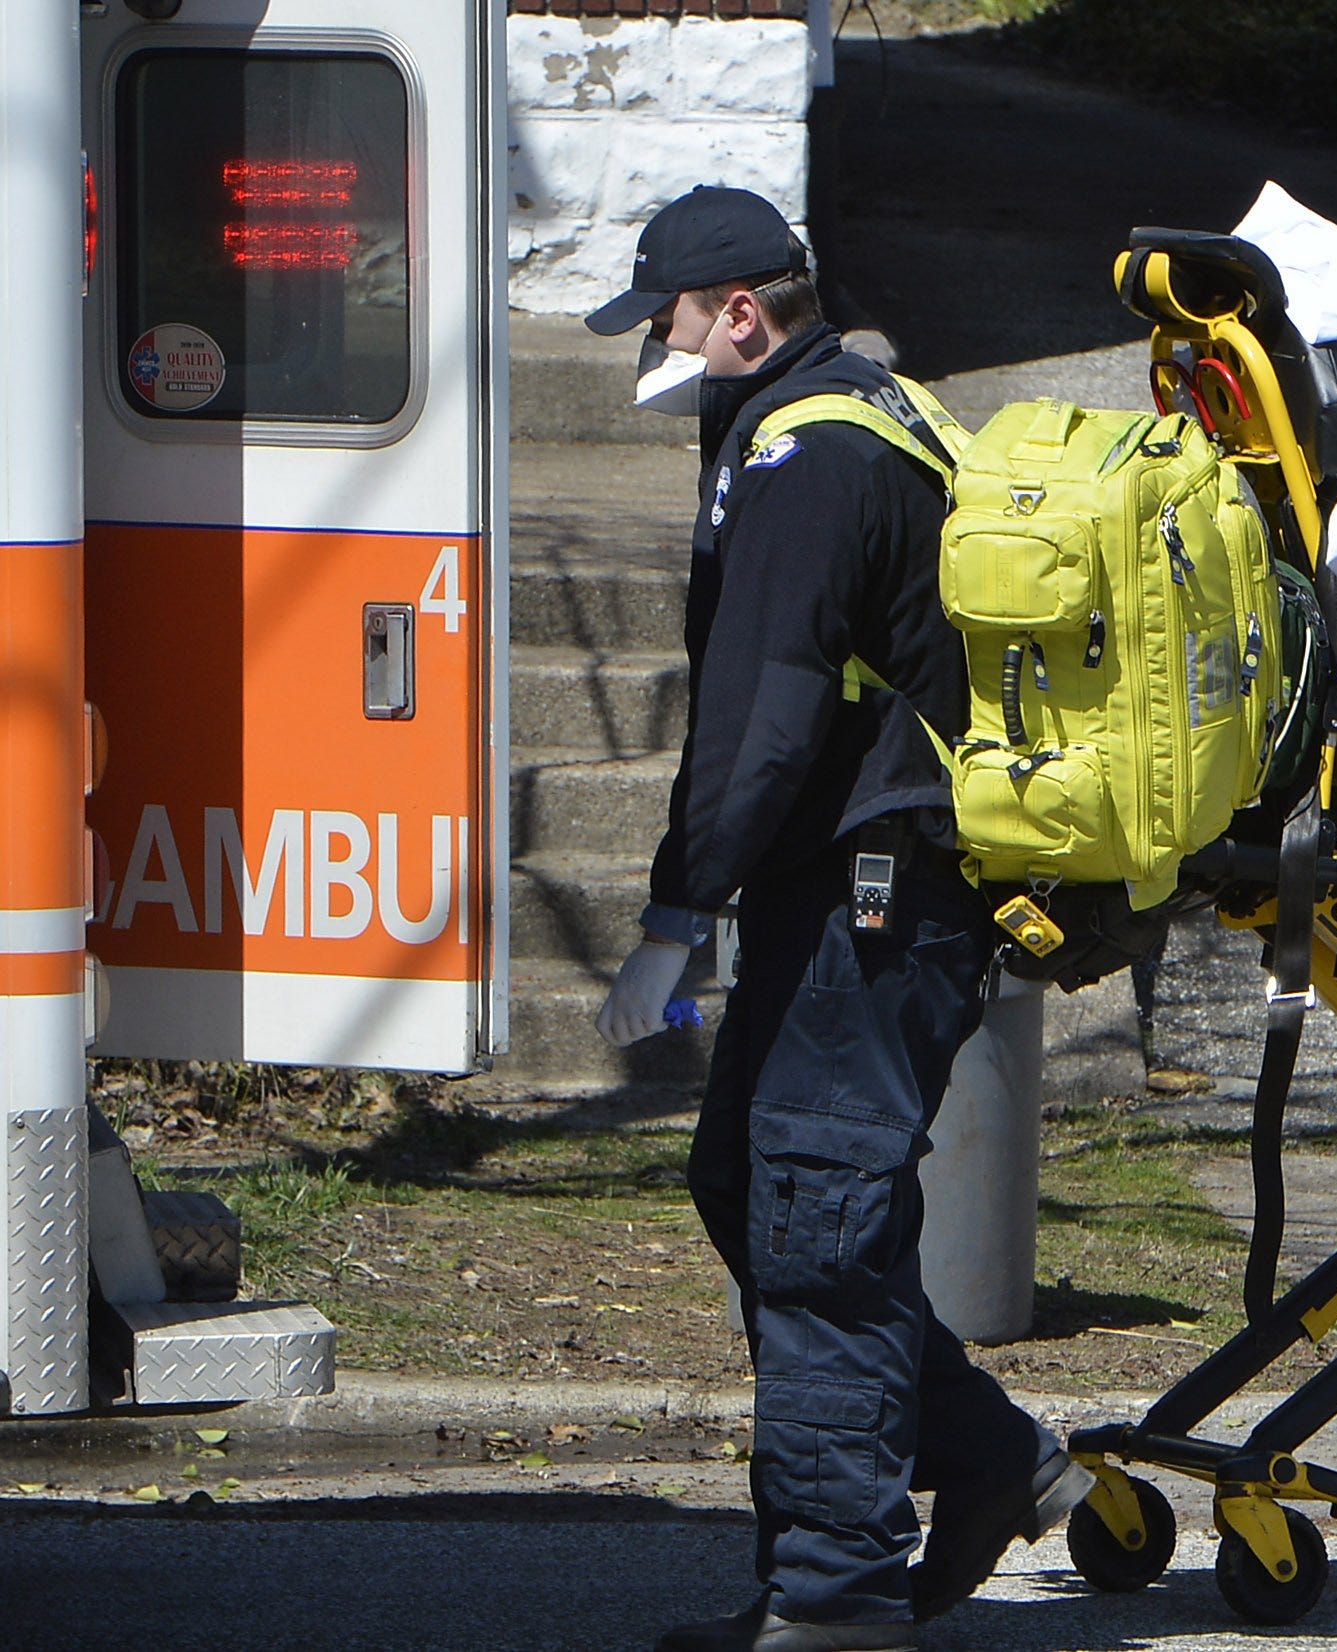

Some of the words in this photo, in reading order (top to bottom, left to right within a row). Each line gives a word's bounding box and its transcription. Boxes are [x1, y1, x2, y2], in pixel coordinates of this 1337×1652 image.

[167, 352, 213, 367] QUALITY
[162, 370, 219, 381] ACHIEVEMENT
[419, 545, 467, 633] 4
